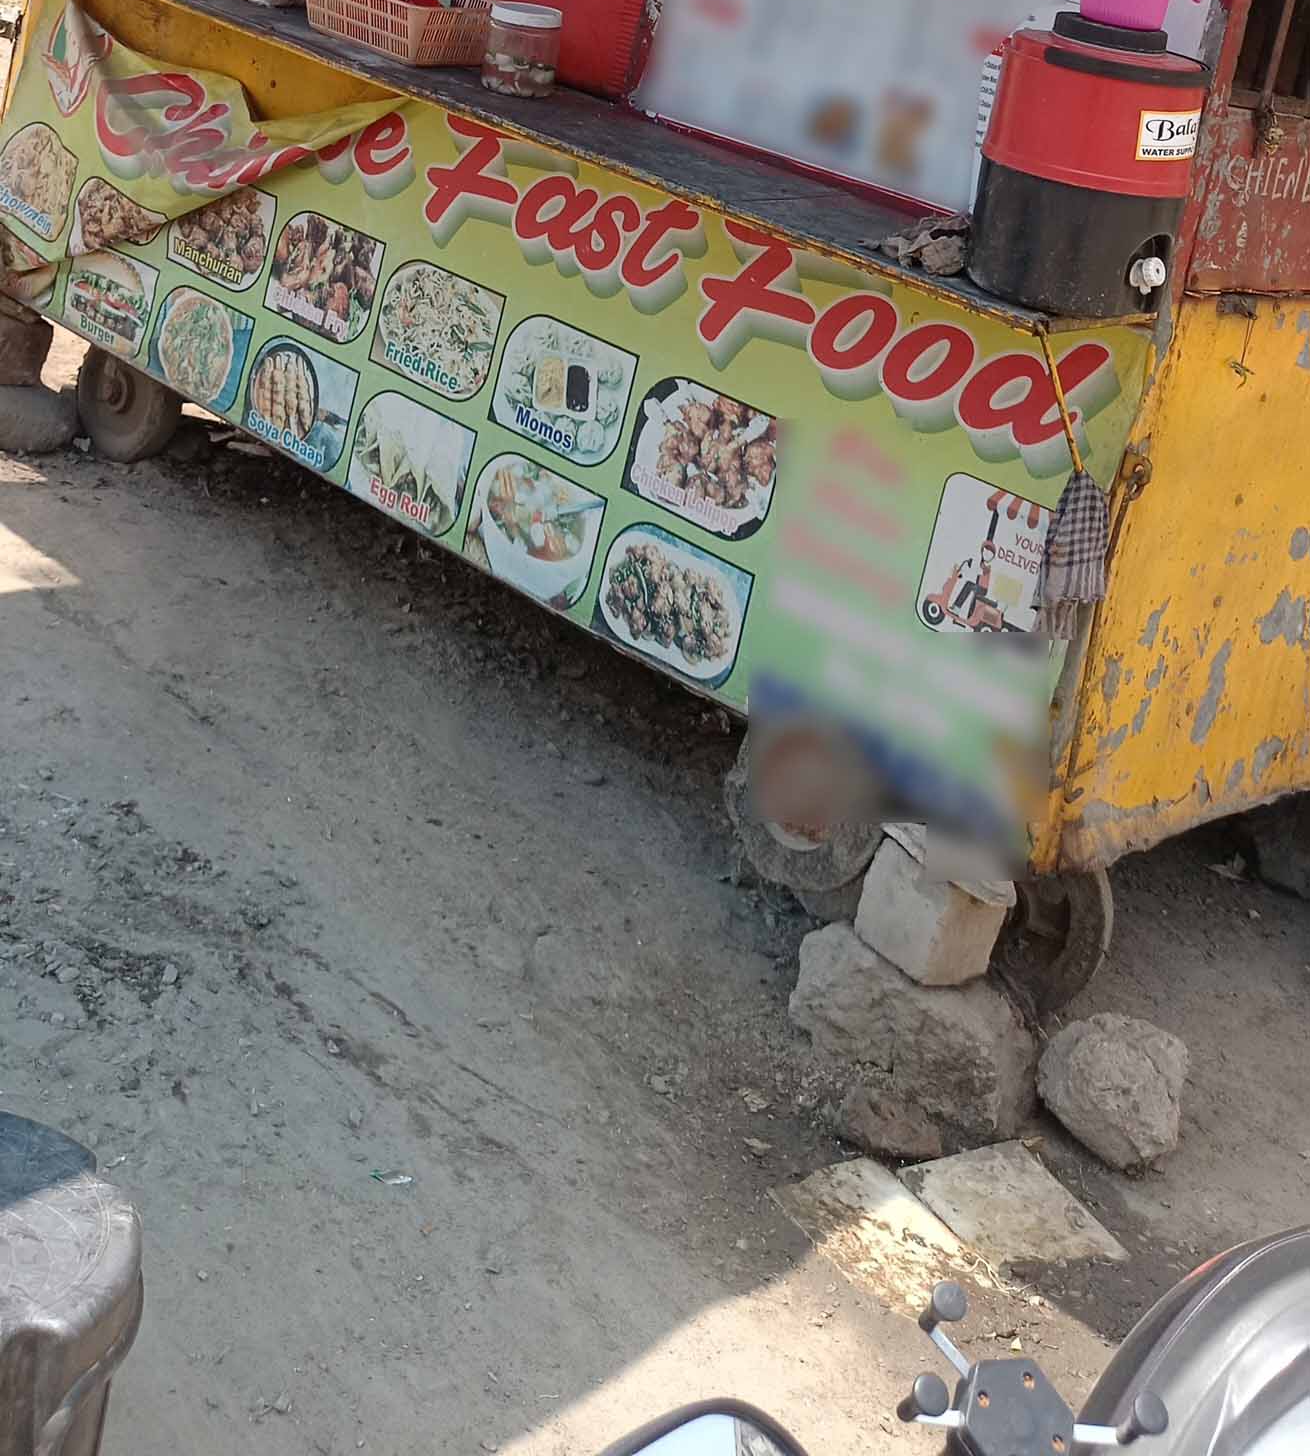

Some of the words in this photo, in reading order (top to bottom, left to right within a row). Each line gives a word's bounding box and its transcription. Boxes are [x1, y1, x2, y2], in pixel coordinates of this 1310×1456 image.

[1142, 148, 1175, 157] WATER
[174, 236, 243, 285] Manchurian
[425, 112, 700, 288] Fast
[700, 219, 1110, 446] Food
[80, 314, 115, 344] Burger
[385, 341, 422, 373] Fried
[425, 365, 458, 391] Rice
[249, 410, 279, 440] Soya
[283, 431, 324, 466] Chaap
[516, 405, 572, 450] Momos
[370, 479, 395, 507] Egg
[400, 493, 431, 524] Roll
